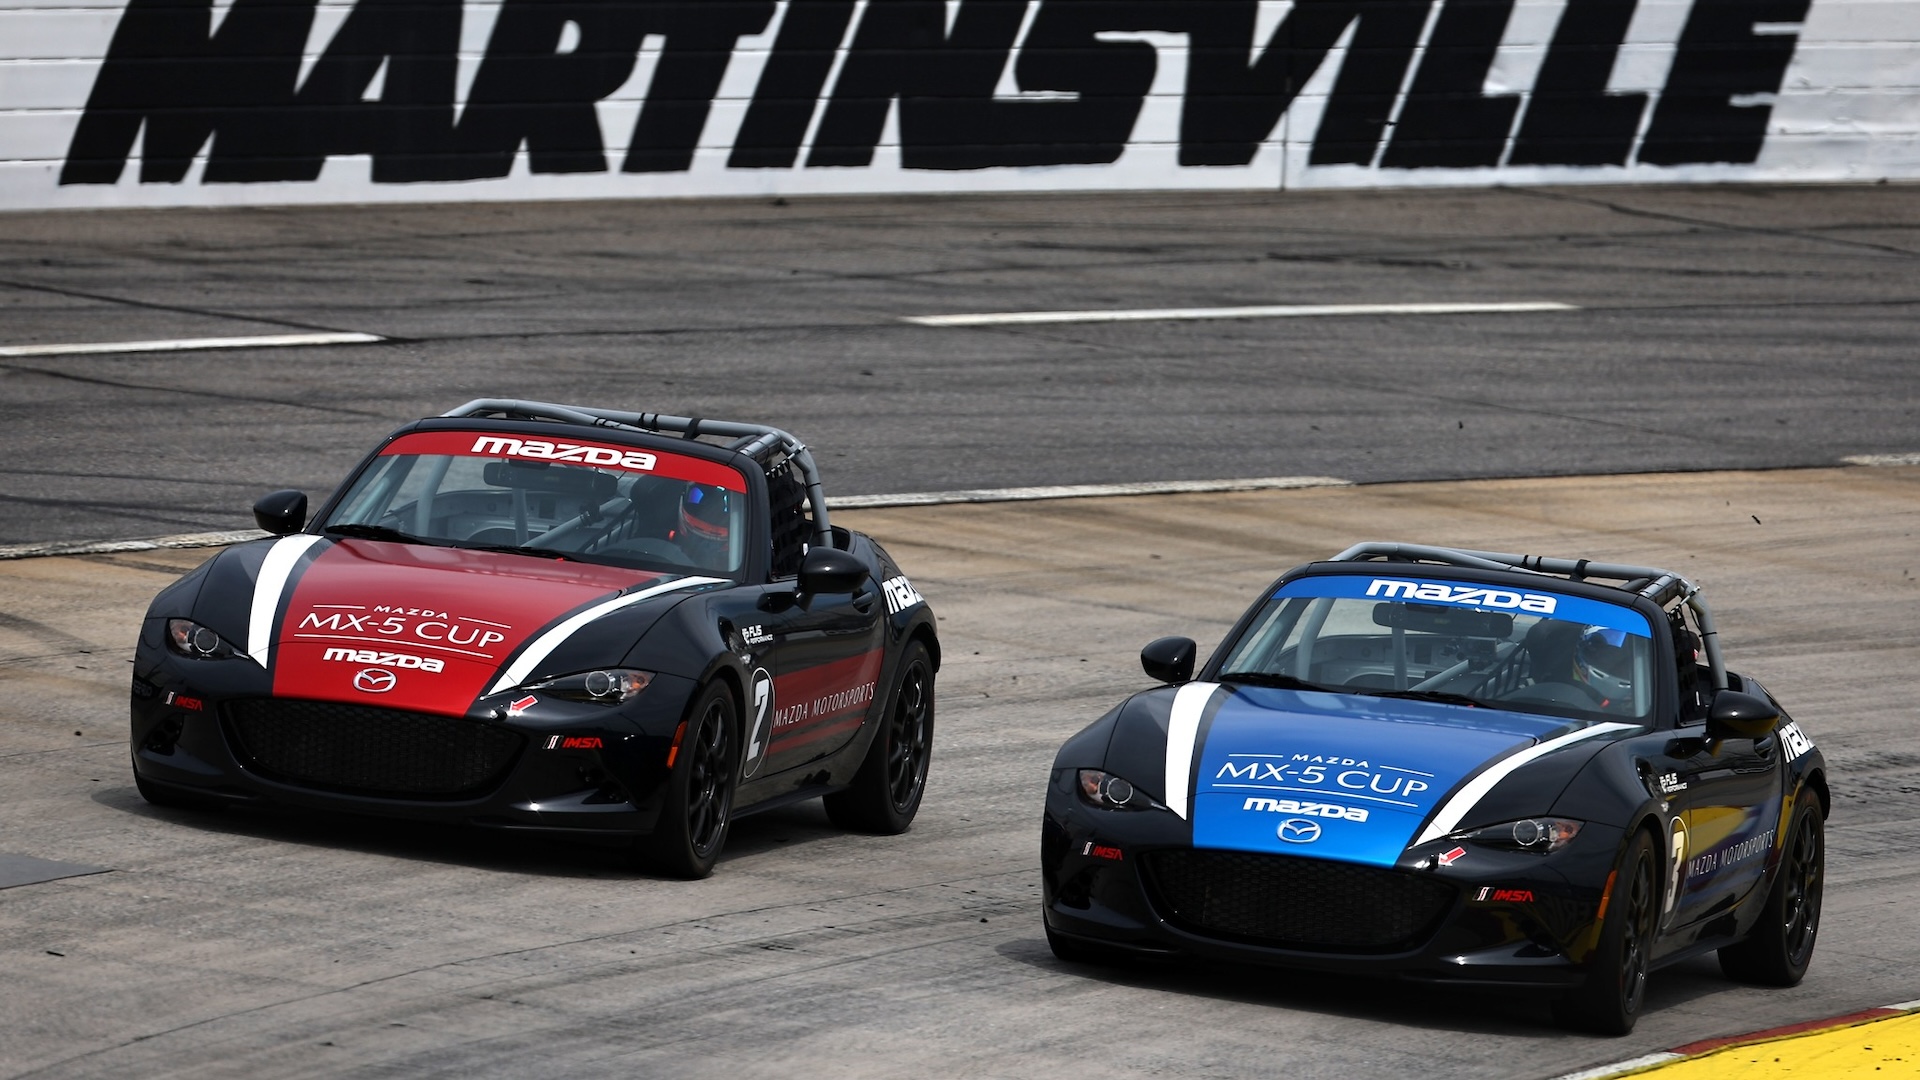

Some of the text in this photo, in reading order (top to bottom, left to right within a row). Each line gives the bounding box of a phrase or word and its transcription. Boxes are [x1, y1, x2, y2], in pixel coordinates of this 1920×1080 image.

[58, 0, 1812, 186] MARTINSVILLE
[471, 436, 657, 470] mazda
[373, 605, 450, 620] MAZDA
[1365, 579, 1557, 614] mazda
[298, 613, 505, 648] MX-5 CUP
[322, 647, 446, 674] mazda
[174, 696, 203, 712] IMSA
[747, 679, 769, 761] 2
[773, 681, 875, 729] MAZDA MOTORSPORTS
[562, 736, 604, 749] IMSA
[1291, 753, 1370, 769] MAZDA
[1215, 761, 1429, 798] MX-5 CUP
[1242, 797, 1370, 823] mazda
[1092, 844, 1123, 861] IMSA
[1686, 829, 1775, 879] MAZDA MOTORSPORTS
[1664, 830, 1685, 915] 3
[1492, 888, 1535, 902] IMSA
